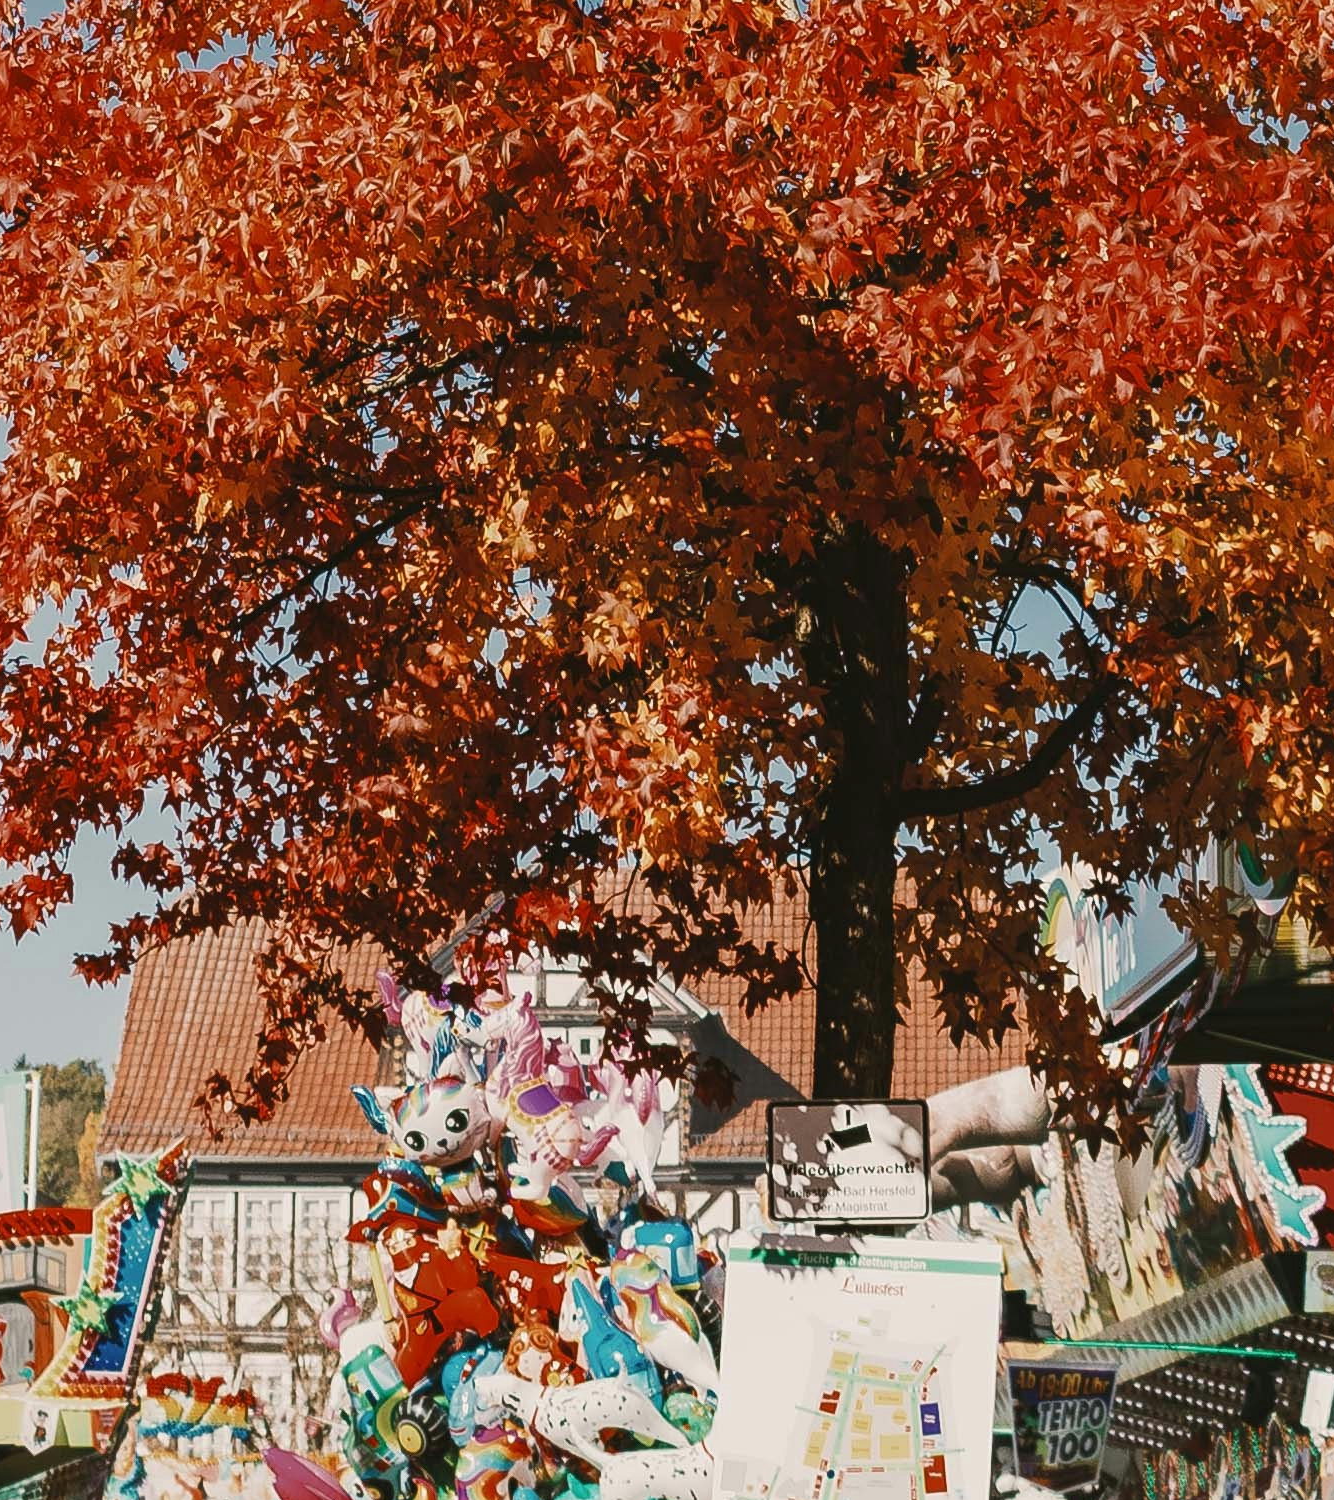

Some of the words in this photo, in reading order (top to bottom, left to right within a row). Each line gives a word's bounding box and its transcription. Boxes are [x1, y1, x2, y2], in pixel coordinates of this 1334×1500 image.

[783, 1160, 916, 1177] Videoüberwacht!
[843, 1186, 870, 1197] Bad
[871, 1185, 916, 1197] Hersfeld
[813, 1203, 831, 1213] Der
[835, 1202, 889, 1214] Magistrat
[841, 1274, 906, 1297] Lullusfest
[1038, 1399, 1107, 1434] TEMPO
[1047, 1431, 1100, 1465] 100
